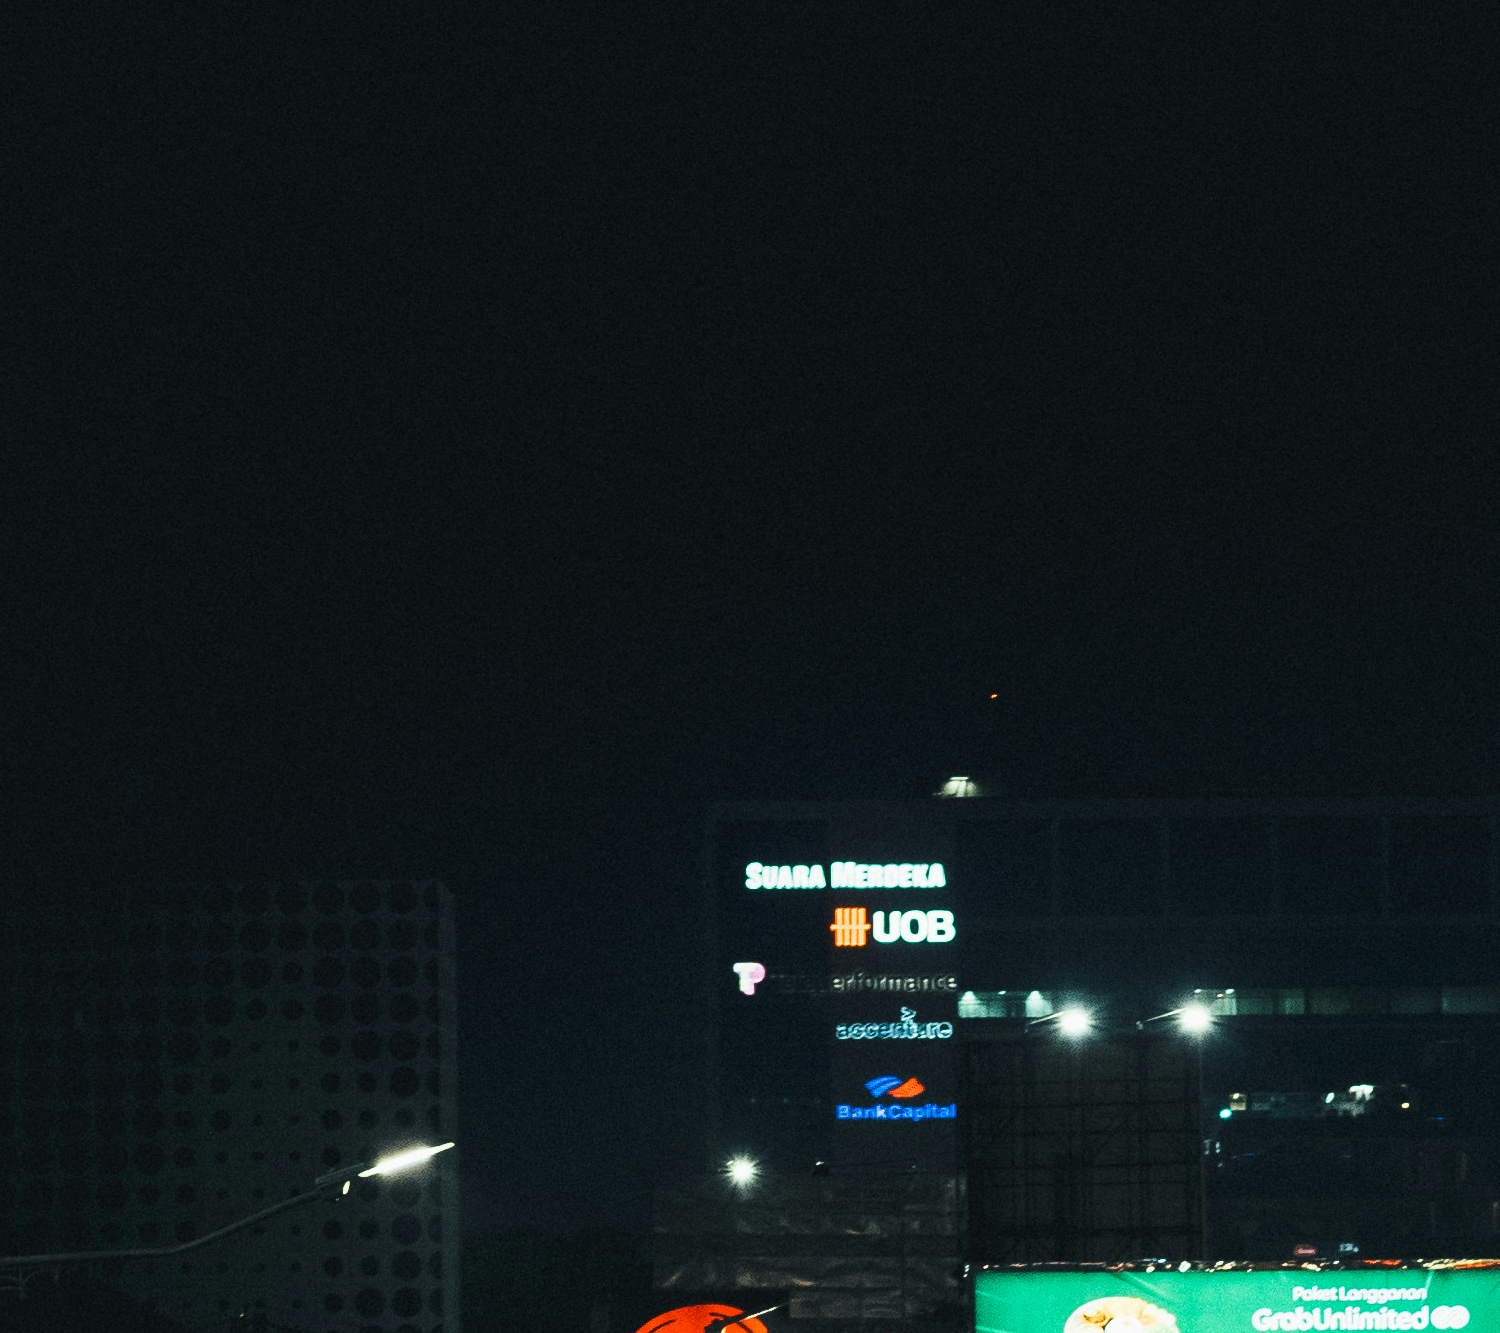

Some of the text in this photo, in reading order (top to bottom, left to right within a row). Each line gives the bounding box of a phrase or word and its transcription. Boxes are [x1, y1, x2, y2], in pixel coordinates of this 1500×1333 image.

[872, 910, 957, 943] UOB
[836, 1015, 953, 1039] accenture
[1292, 1285, 1428, 1304] Paket Langganan
[1252, 1306, 1429, 1331] GrabUnlimited
